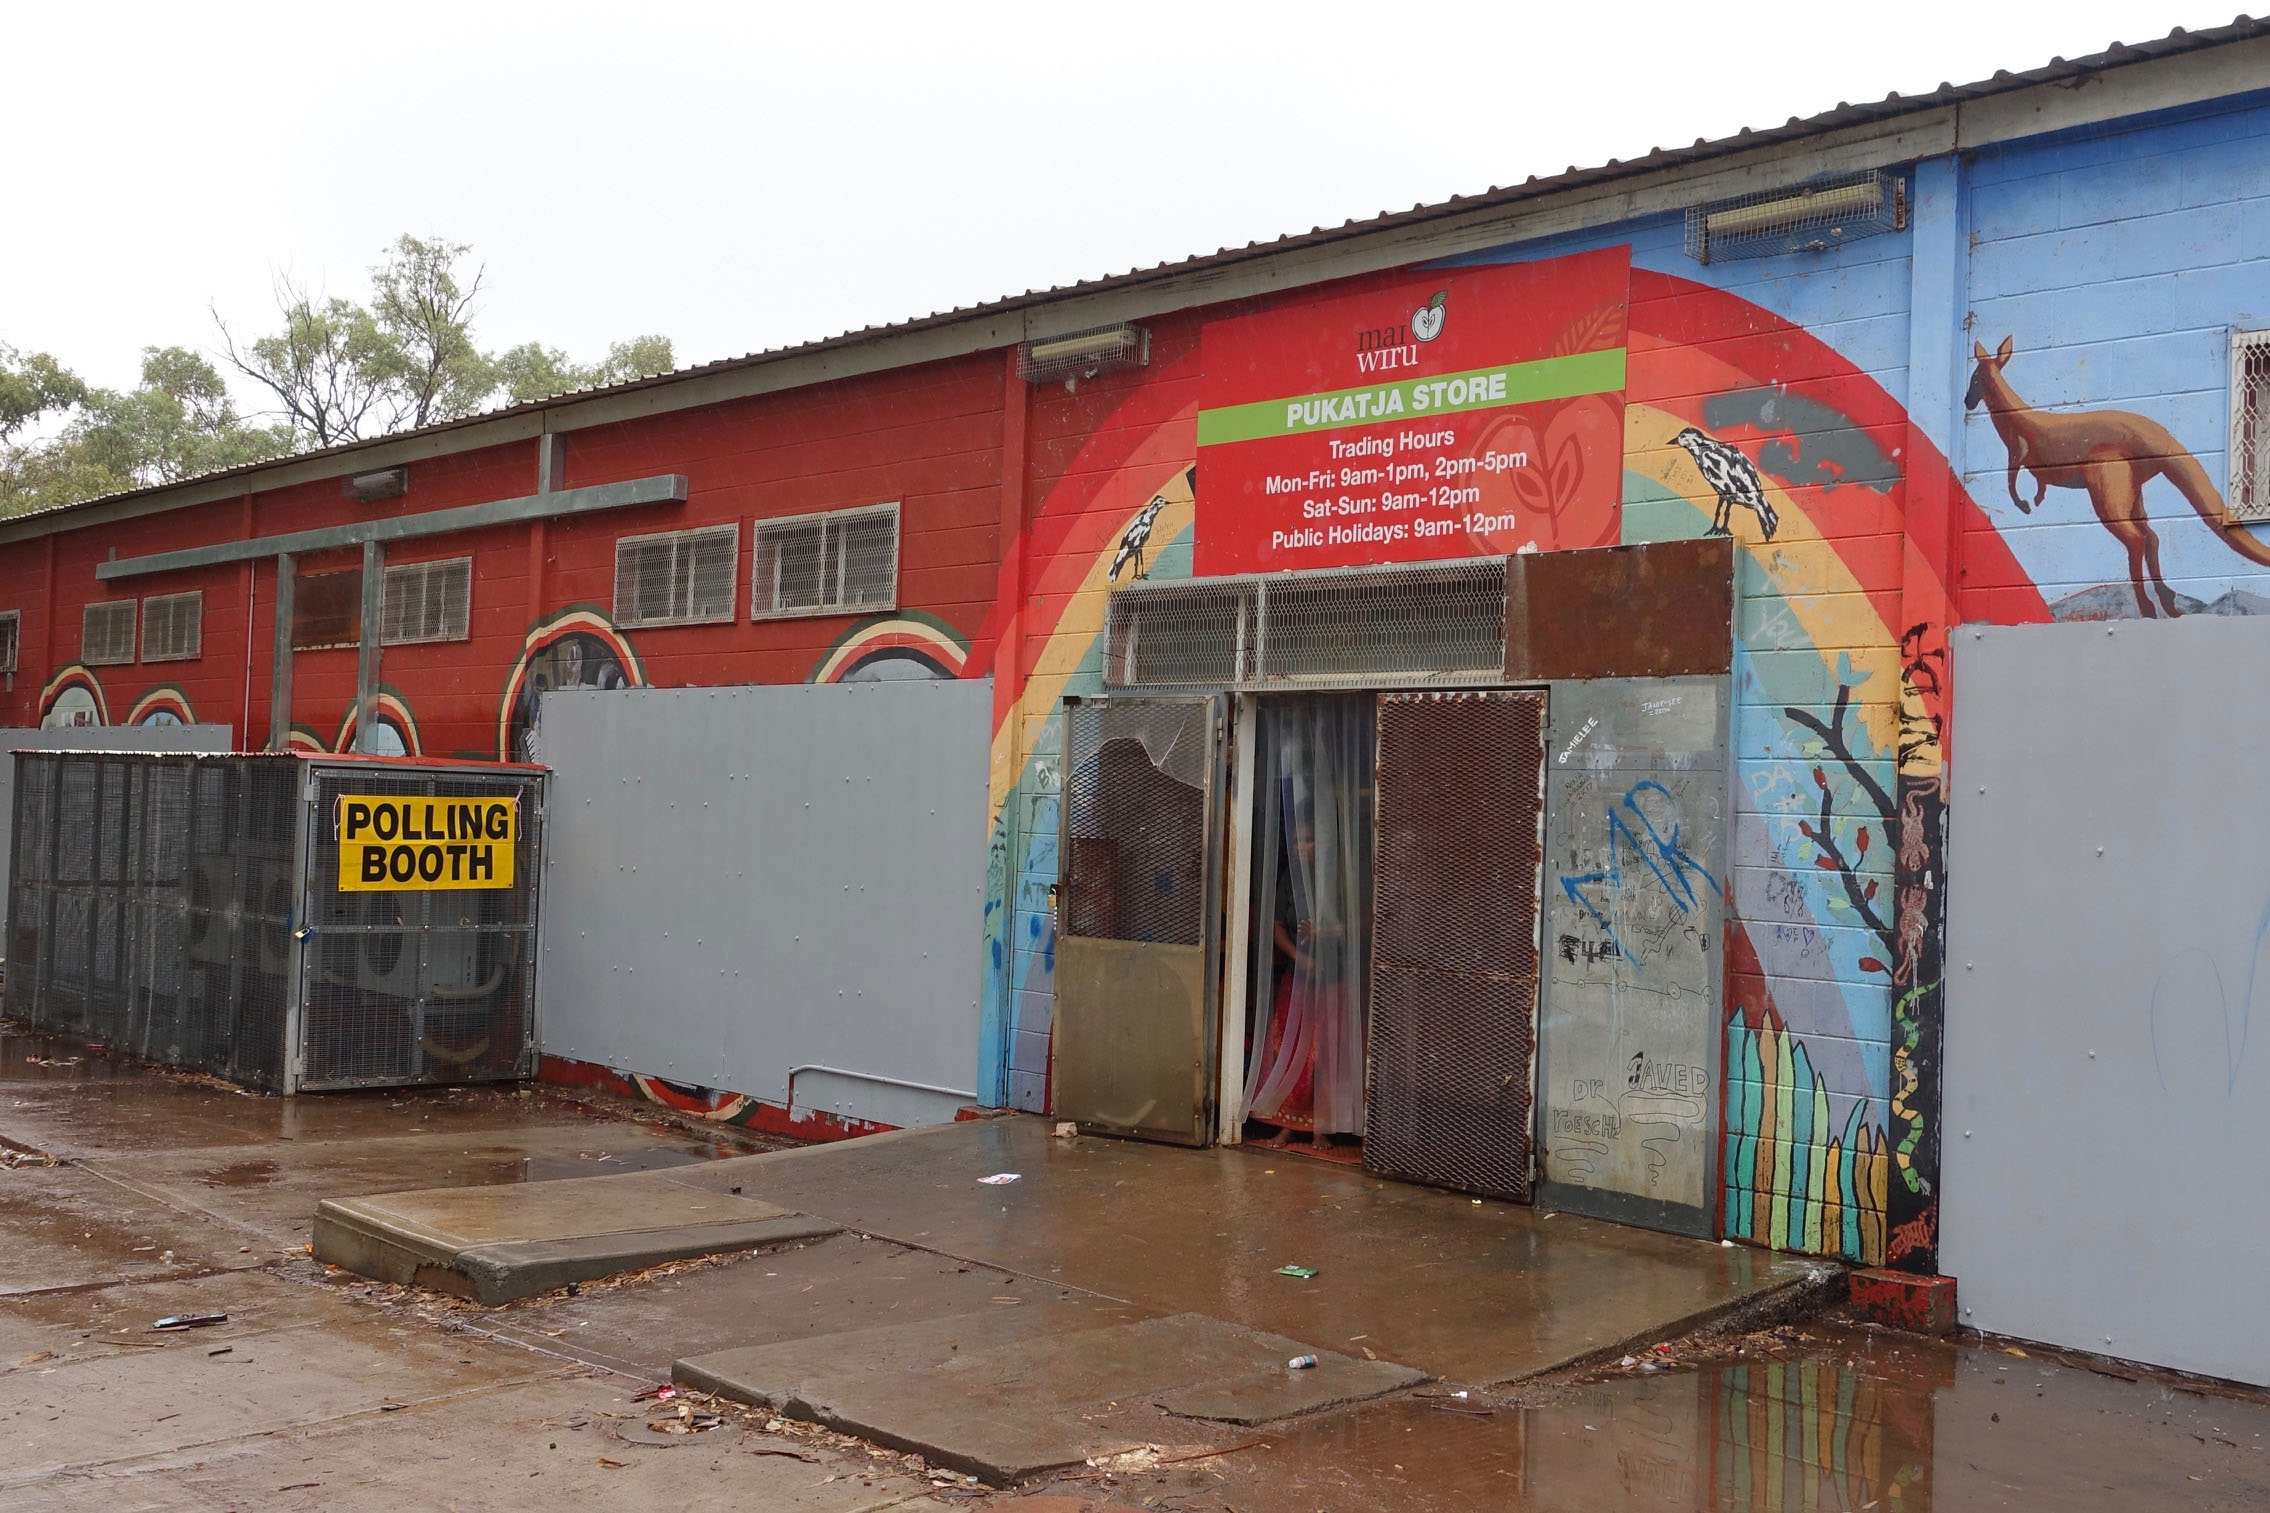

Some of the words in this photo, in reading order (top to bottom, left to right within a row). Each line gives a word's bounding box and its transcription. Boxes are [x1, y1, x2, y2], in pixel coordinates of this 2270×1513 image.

[1356, 344, 1419, 374] wiru
[1286, 388, 1404, 428] PUKATJA
[1412, 372, 1508, 411] STORE
[1329, 435, 1395, 459] Trading
[1399, 429, 1456, 451] Hours
[1265, 468, 1337, 495] Mon-Fri:
[1339, 461, 1430, 486] 9am-1pm,
[1434, 450, 1528, 480] 2pm-5pm
[1302, 494, 1377, 519] Sat-Sun:
[1380, 486, 1481, 511] 9am-12pm
[1271, 527, 1324, 550] Public
[1328, 521, 1410, 545] Holidays:
[1413, 512, 1516, 537] 9am-12pm
[346, 802, 509, 841] POLLING
[361, 844, 494, 883] BOOTH
